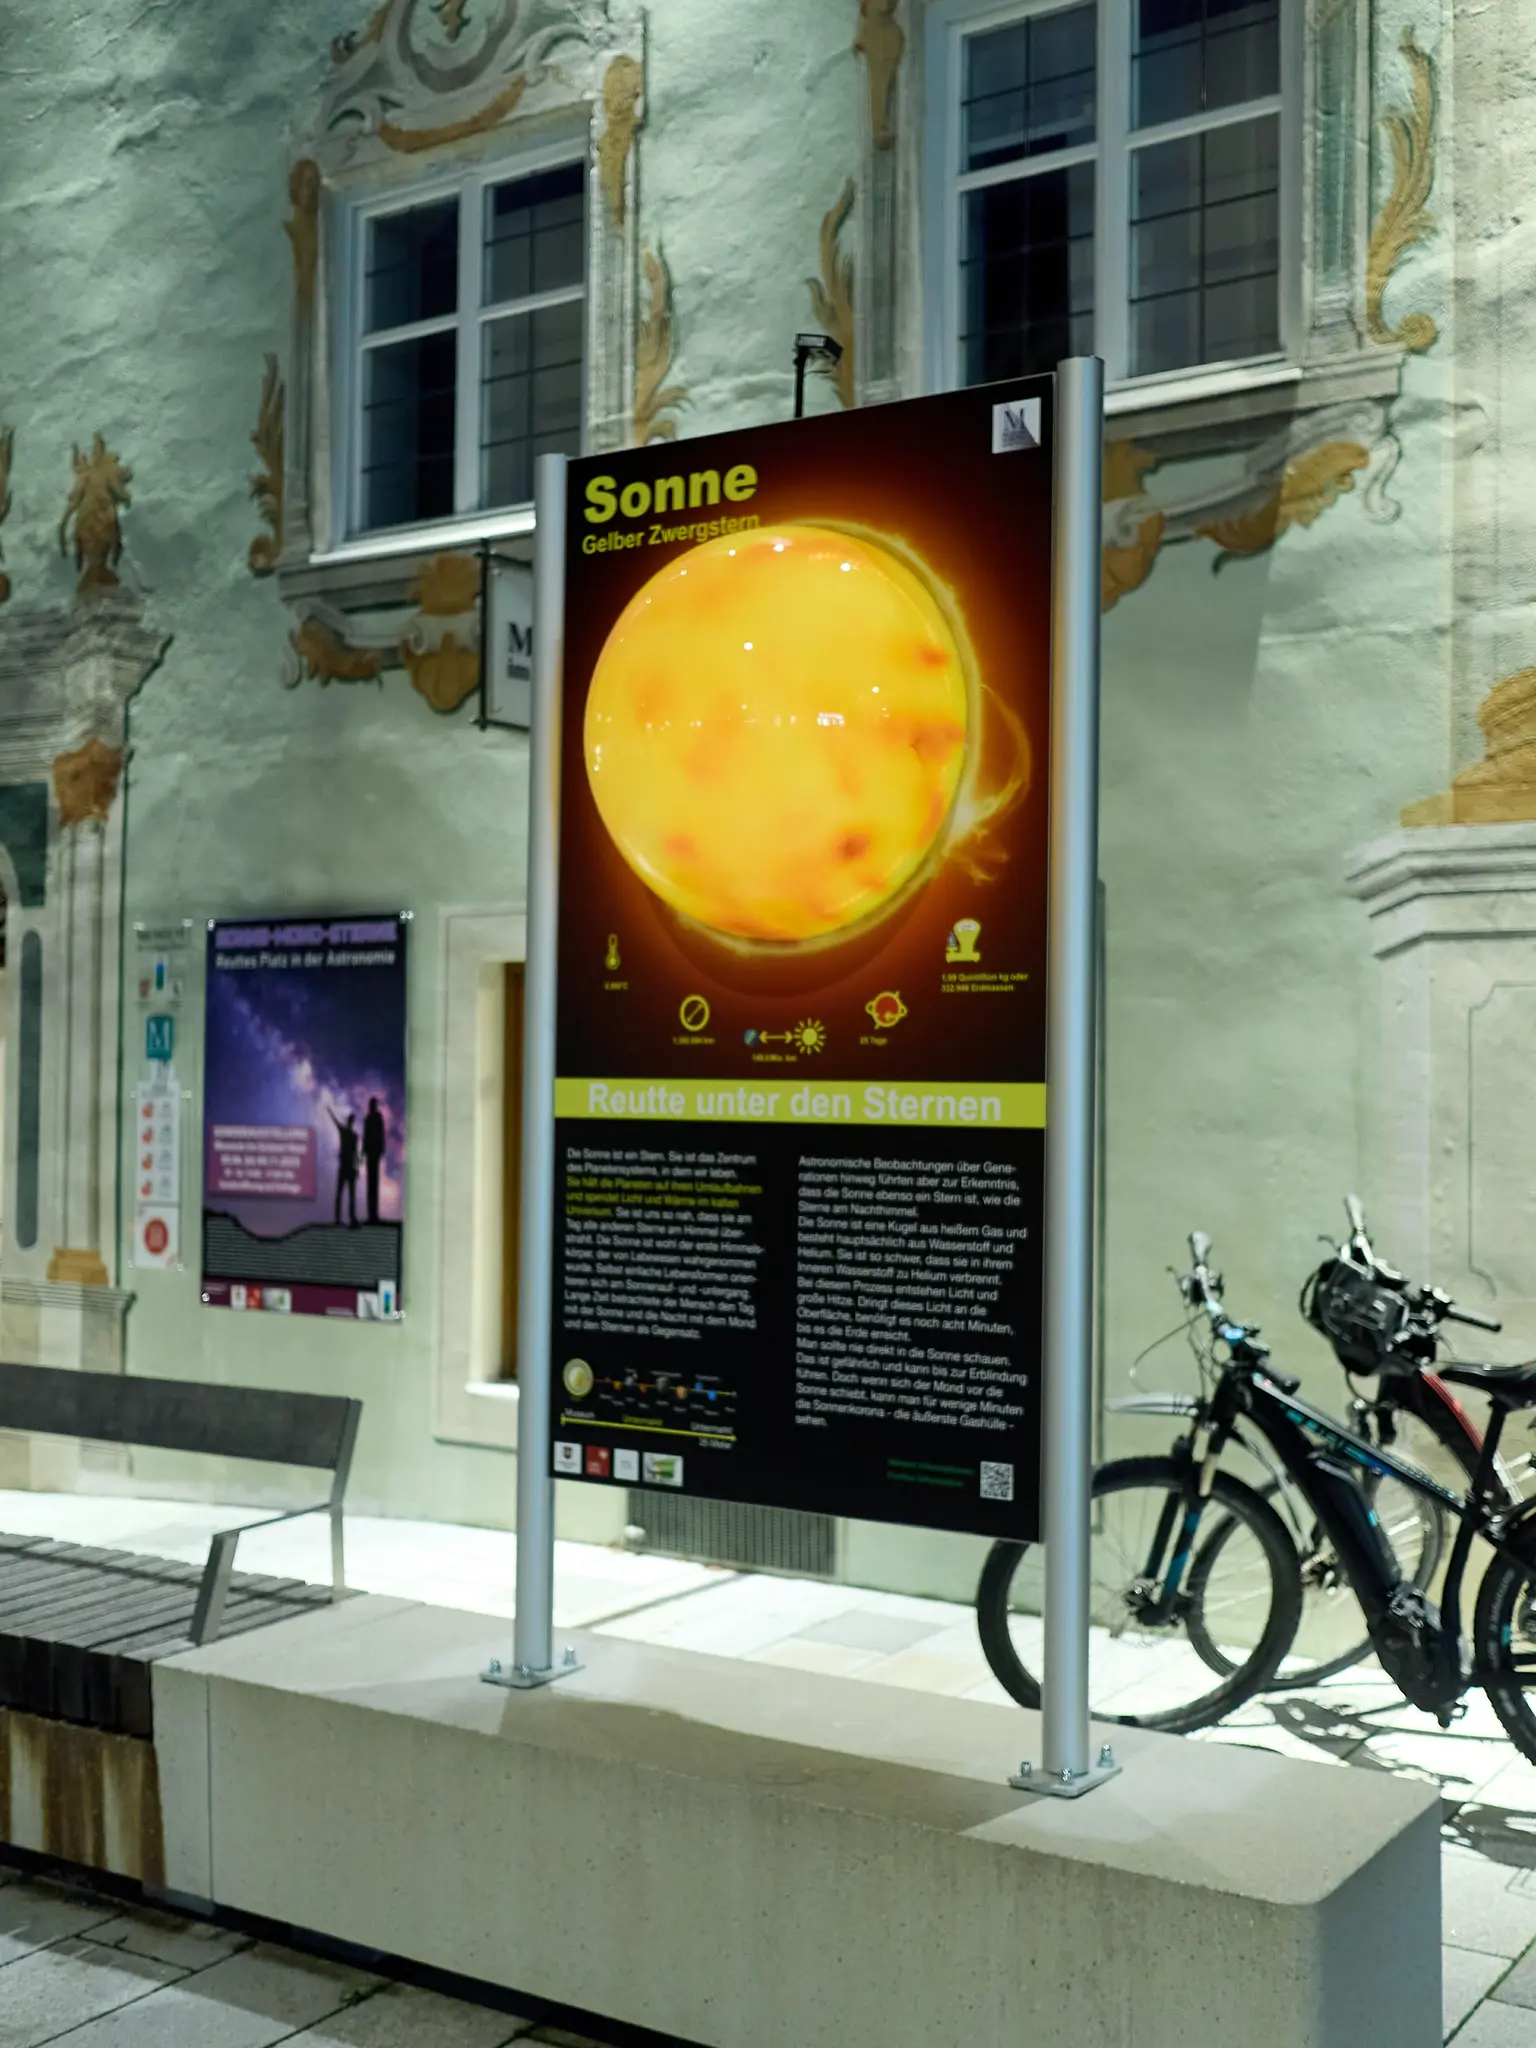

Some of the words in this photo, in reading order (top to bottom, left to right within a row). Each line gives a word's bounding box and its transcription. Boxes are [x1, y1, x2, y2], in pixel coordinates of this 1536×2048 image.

[583, 464, 759, 524] Sonne
[581, 530, 645, 555] Gelber
[647, 514, 760, 544] Zwergstern
[588, 1082, 686, 1116] Reutte
[696, 1086, 780, 1117] unter
[790, 1085, 850, 1118] den
[863, 1085, 1002, 1121] Sternen
[955, 1159, 981, 1172] über
[982, 1160, 1016, 1174] Gene-
[941, 1177, 959, 1188] zur
[932, 1190, 962, 1203] Stern
[981, 1192, 1002, 1205] wie
[1002, 1193, 1021, 1206] die
[940, 1222, 980, 1236] heißem
[980, 1224, 1004, 1237] Gas
[1005, 1225, 1027, 1238] und
[992, 1240, 1014, 1253] und
[951, 1254, 969, 1267] sie
[970, 1255, 981, 1268] in
[982, 1255, 1013, 1269] ihrem
[948, 1285, 975, 1299] Licht
[976, 1287, 998, 1300] und
[953, 1304, 968, 1315] an
[969, 1302, 987, 1316] die
[941, 1316, 966, 1330] acht
[931, 1363, 948, 1376] bis
[949, 1367, 967, 1378] zur
[968, 1366, 1026, 1385] Erblindung
[932, 1379, 965, 1394] Mond
[966, 1384, 984, 1395] vor
[985, 1383, 1004, 1397] die
[938, 1395, 978, 1413] wenige
[979, 1398, 1024, 1415] Minuten
[958, 1413, 1007, 1429] Gashülle
